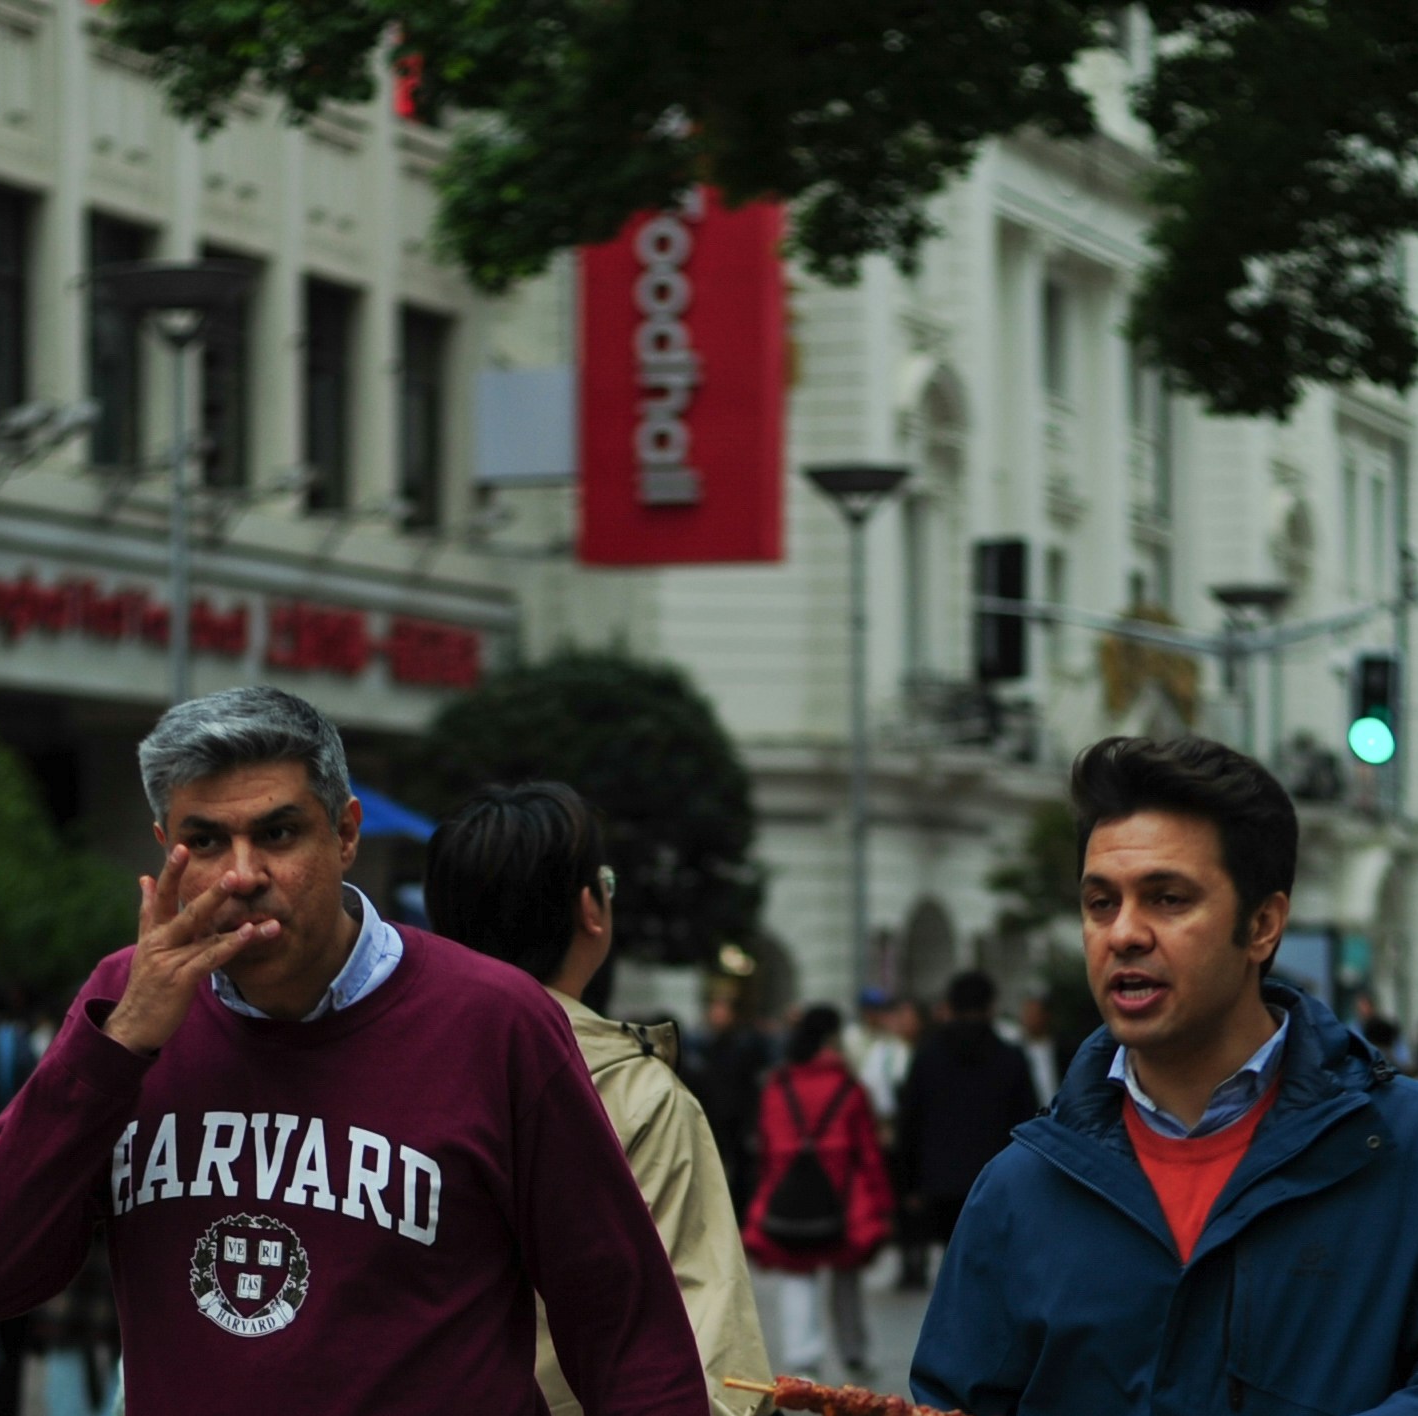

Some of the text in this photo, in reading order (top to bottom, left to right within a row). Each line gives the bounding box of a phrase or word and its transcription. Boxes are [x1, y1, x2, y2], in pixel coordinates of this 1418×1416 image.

[632, 188, 706, 506] oodhall
[111, 1111, 443, 1247] HARVARD
[215, 1308, 276, 1333] HARVARD
